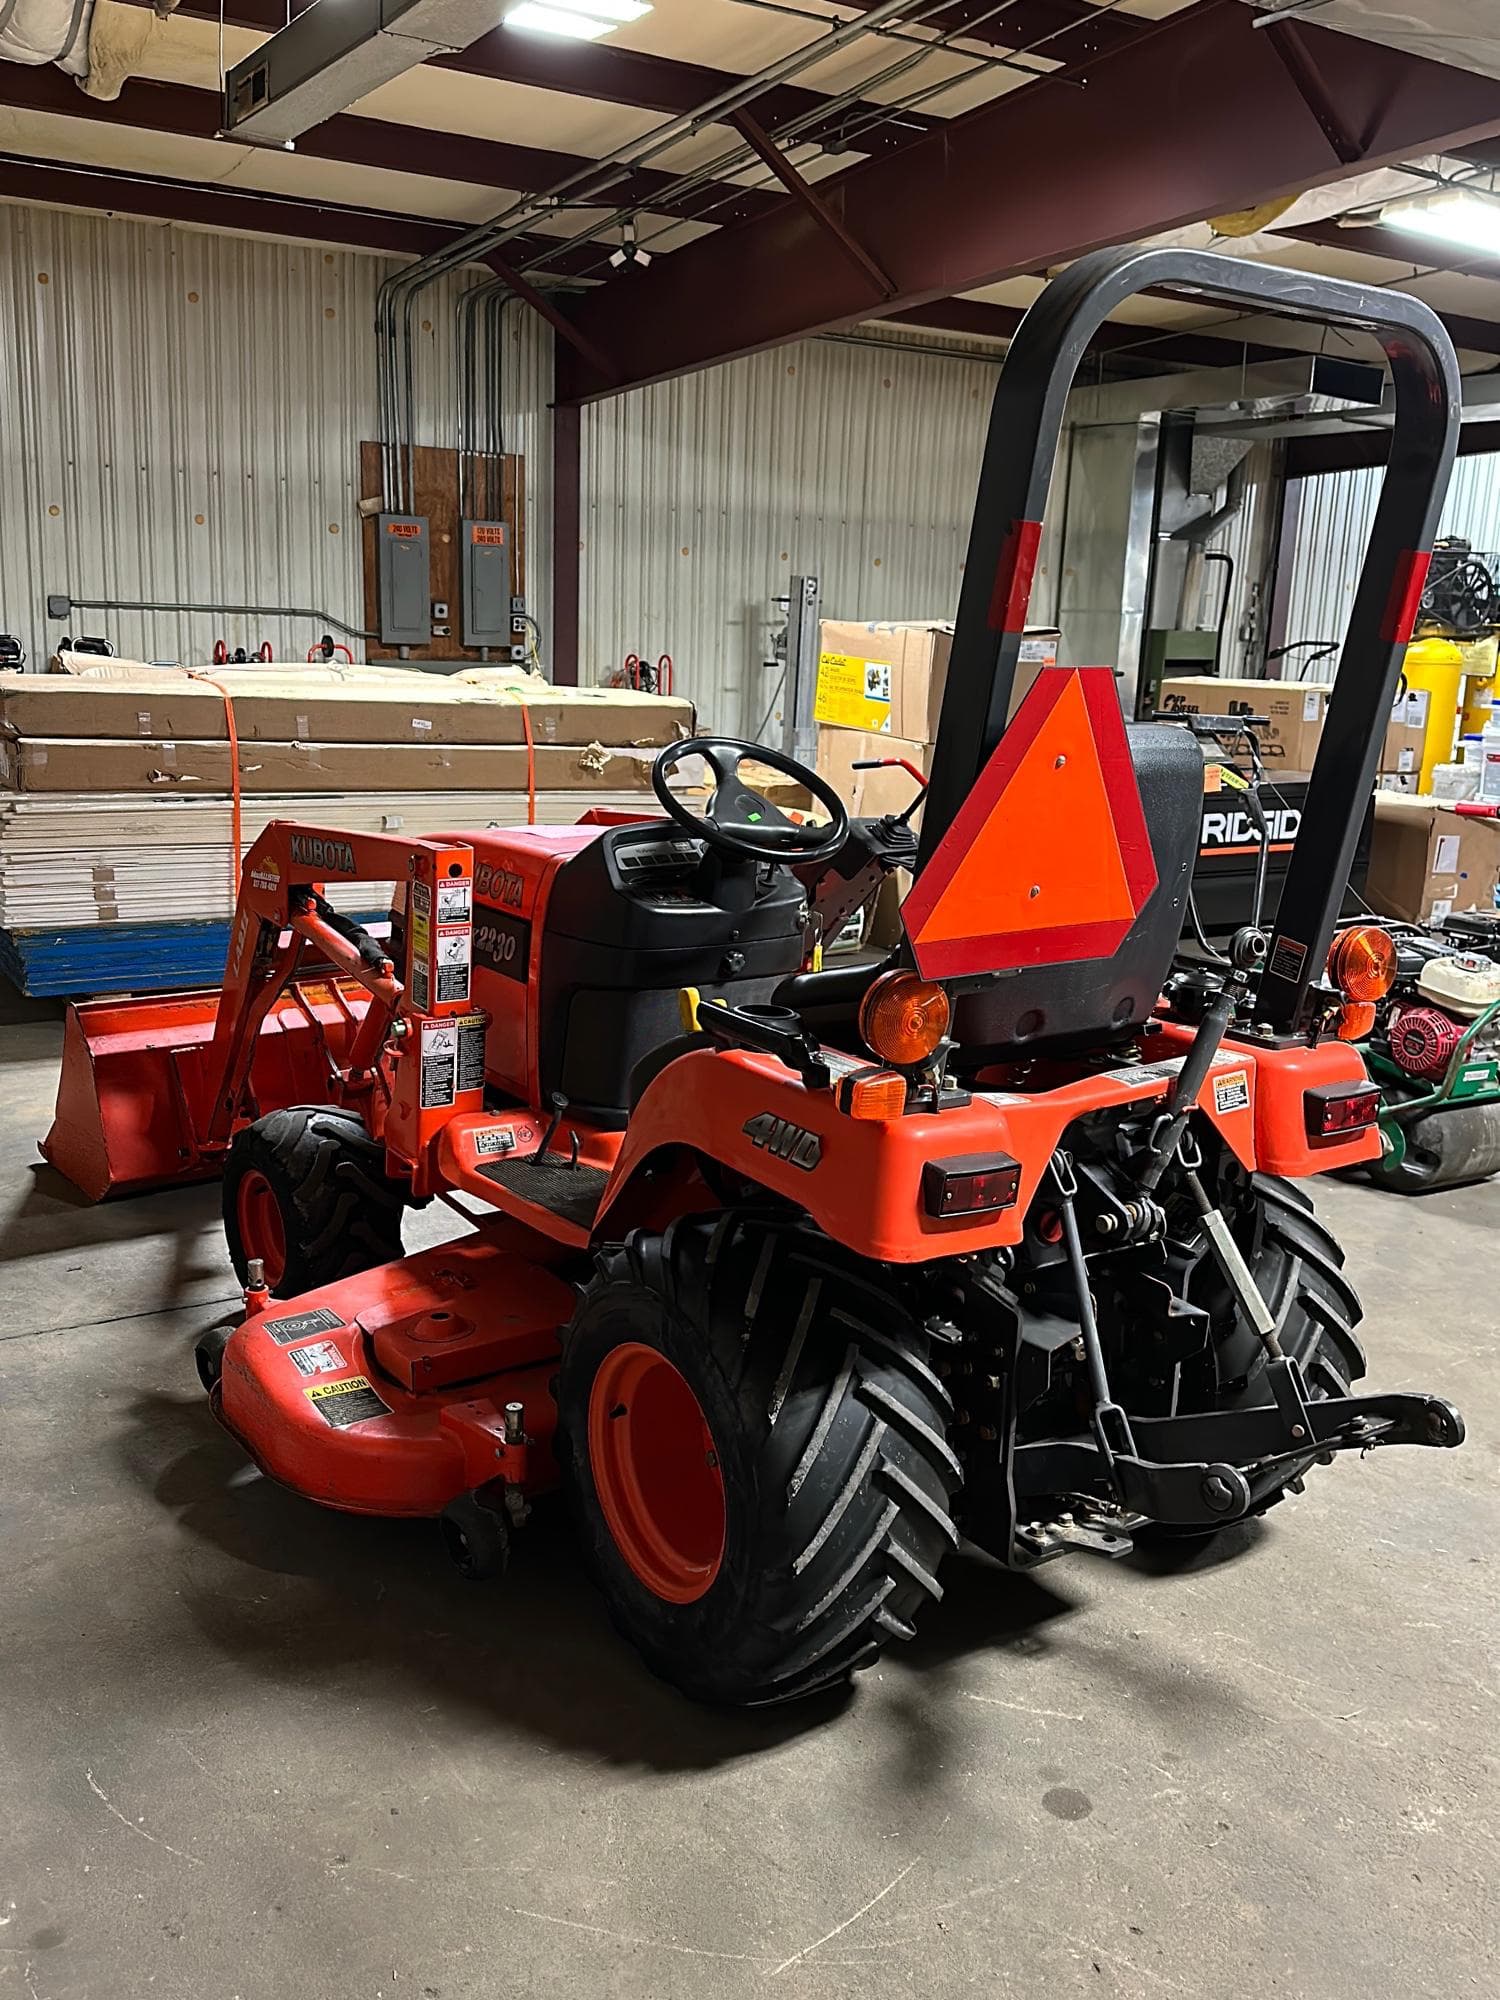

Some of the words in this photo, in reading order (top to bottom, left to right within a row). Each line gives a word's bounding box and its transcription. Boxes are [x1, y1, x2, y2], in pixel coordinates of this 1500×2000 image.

[403, 525, 418, 534] VOLTS
[291, 834, 356, 874] KUBOTA
[430, 1020, 454, 1029] DANGER
[743, 1111, 823, 1172] 4WD
[323, 1378, 367, 1395] CAUTION
